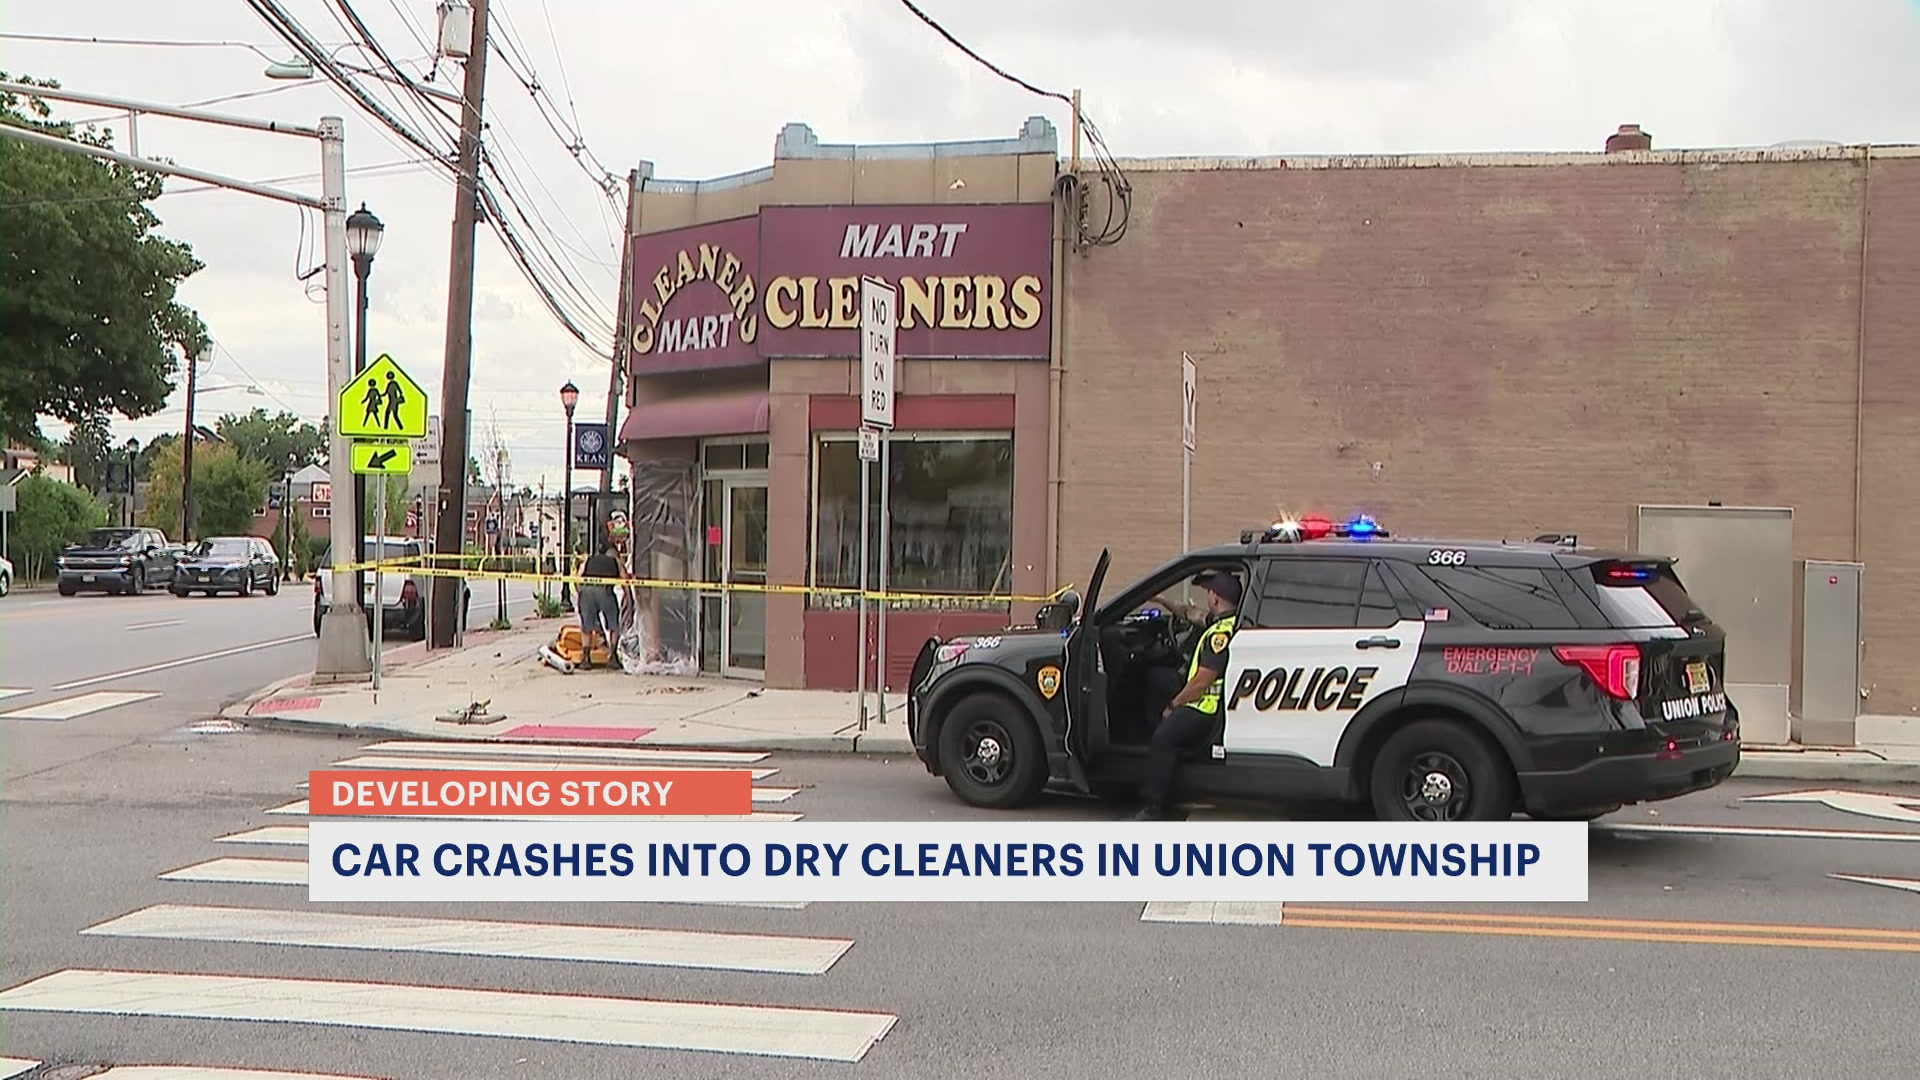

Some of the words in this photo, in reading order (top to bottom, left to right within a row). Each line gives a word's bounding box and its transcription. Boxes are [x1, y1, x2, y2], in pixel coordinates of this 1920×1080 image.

[840, 223, 967, 258] MART
[765, 274, 1042, 329] CLENERS
[871, 296, 887, 325] NO
[657, 312, 735, 354] MART
[869, 330, 889, 355] TURN
[873, 361, 885, 382] ON
[871, 389, 886, 412] RED
[577, 454, 606, 463] KEAN
[1428, 550, 1466, 565] 366
[974, 636, 1002, 649] 366
[1443, 648, 1539, 661] EMERGENCY
[1447, 661, 1483, 673] DIAL
[1490, 662, 1533, 675] 9-1-1
[1227, 667, 1379, 711] POLICE
[1662, 697, 1700, 720] UNION
